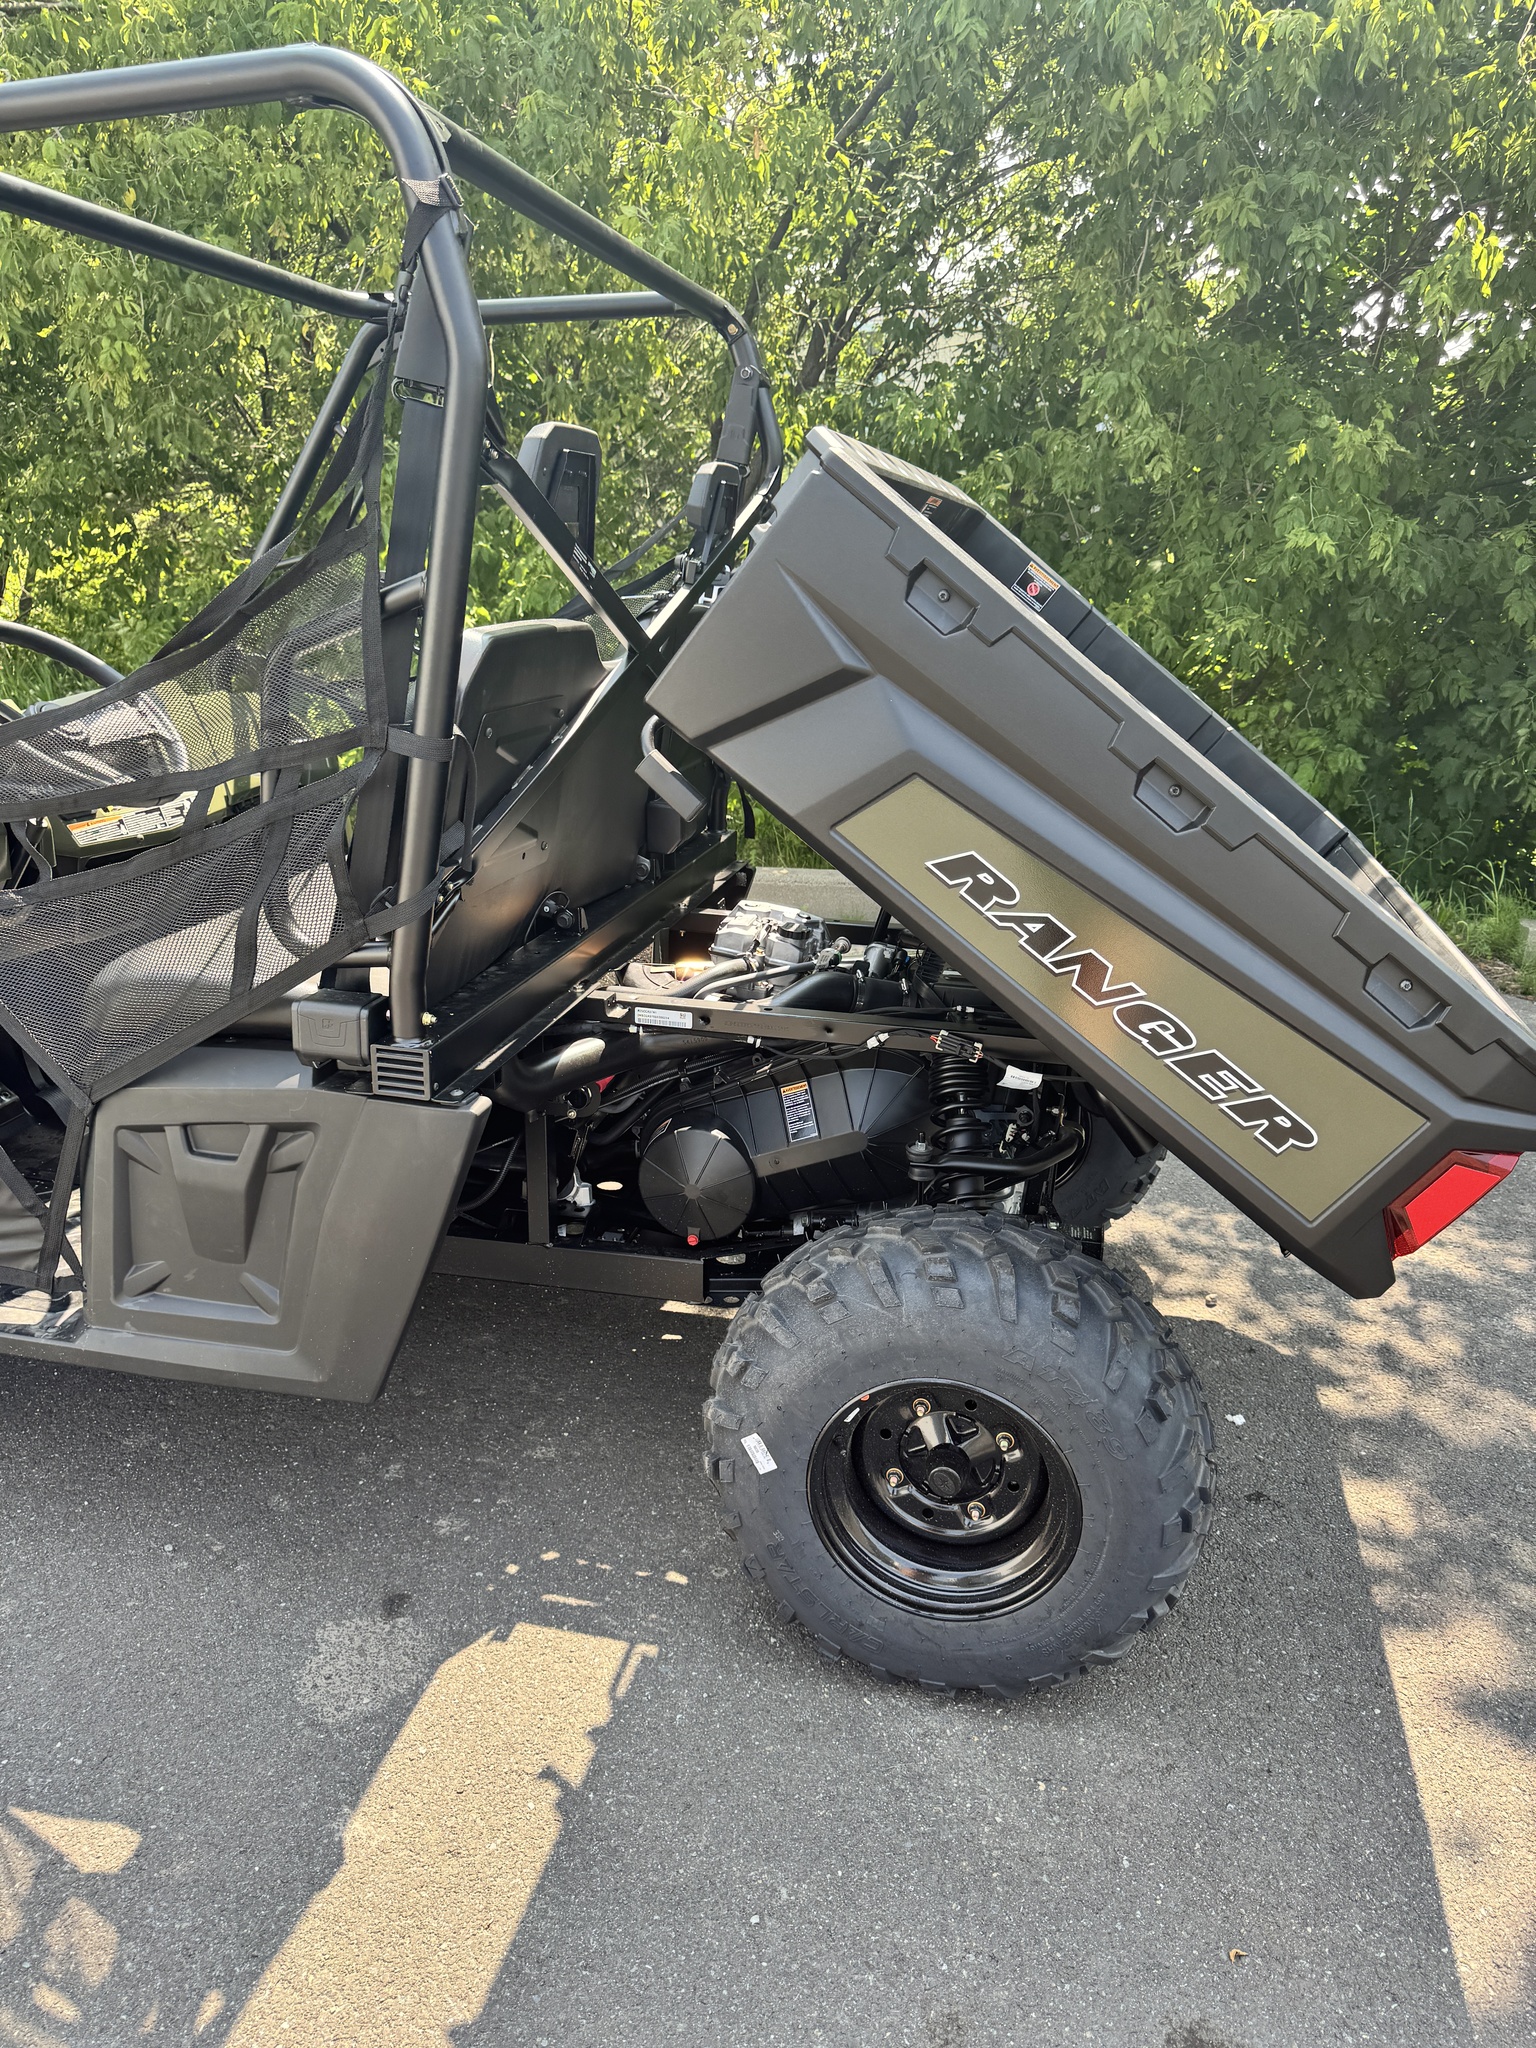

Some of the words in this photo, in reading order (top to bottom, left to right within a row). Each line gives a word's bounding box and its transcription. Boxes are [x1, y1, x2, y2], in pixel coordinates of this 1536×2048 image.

[924, 851, 1319, 1157] RANGER
[1002, 1349, 1127, 1461] AT489
[766, 1542, 884, 1654] CARLSTAR
